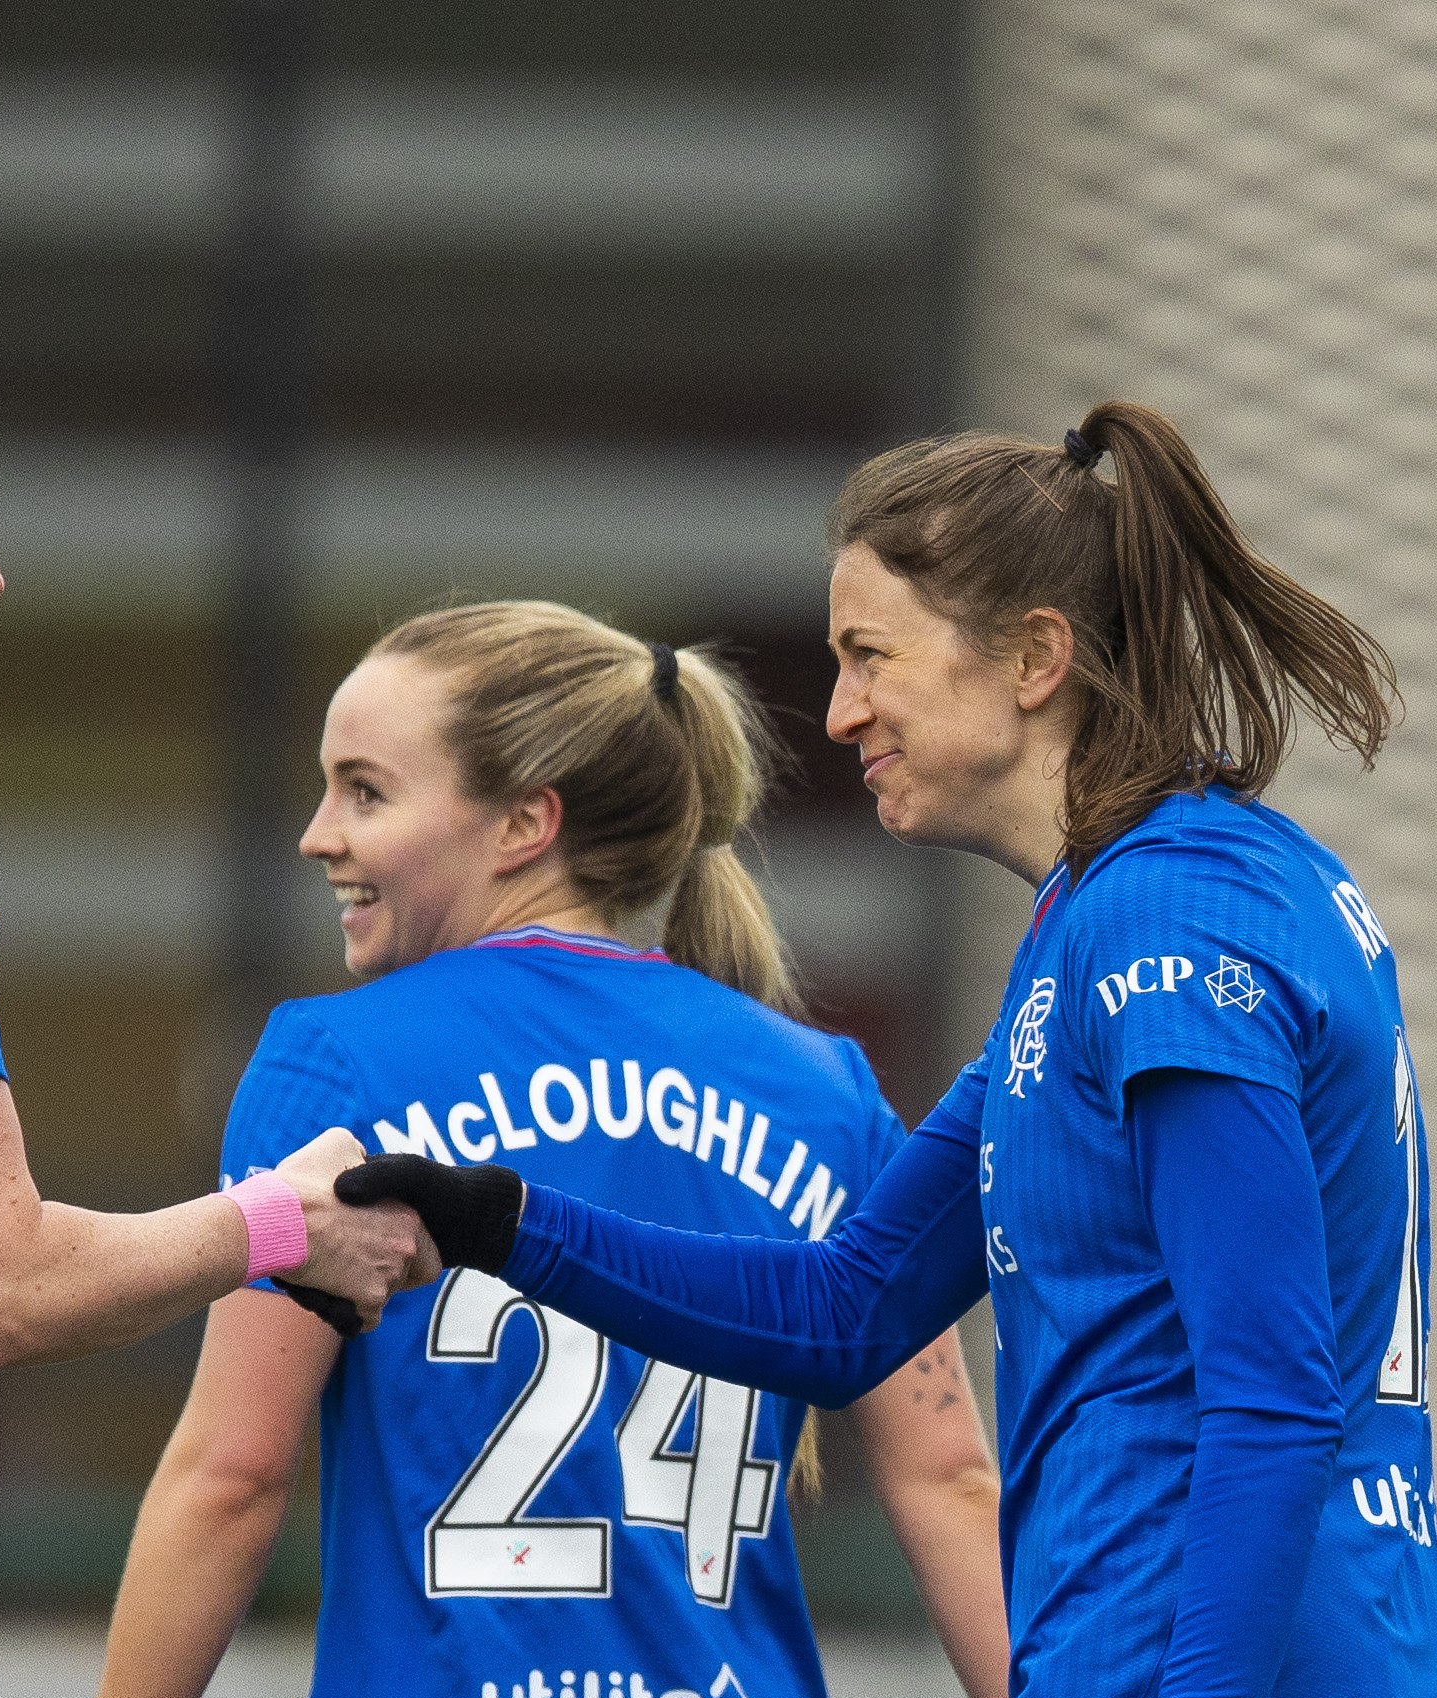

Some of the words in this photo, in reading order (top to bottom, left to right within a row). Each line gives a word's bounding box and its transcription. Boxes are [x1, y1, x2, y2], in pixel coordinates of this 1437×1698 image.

[1096, 956, 1194, 1017] DCP
[373, 1058, 849, 1242] McLOUGHLIN
[425, 1268, 781, 1610] 24
